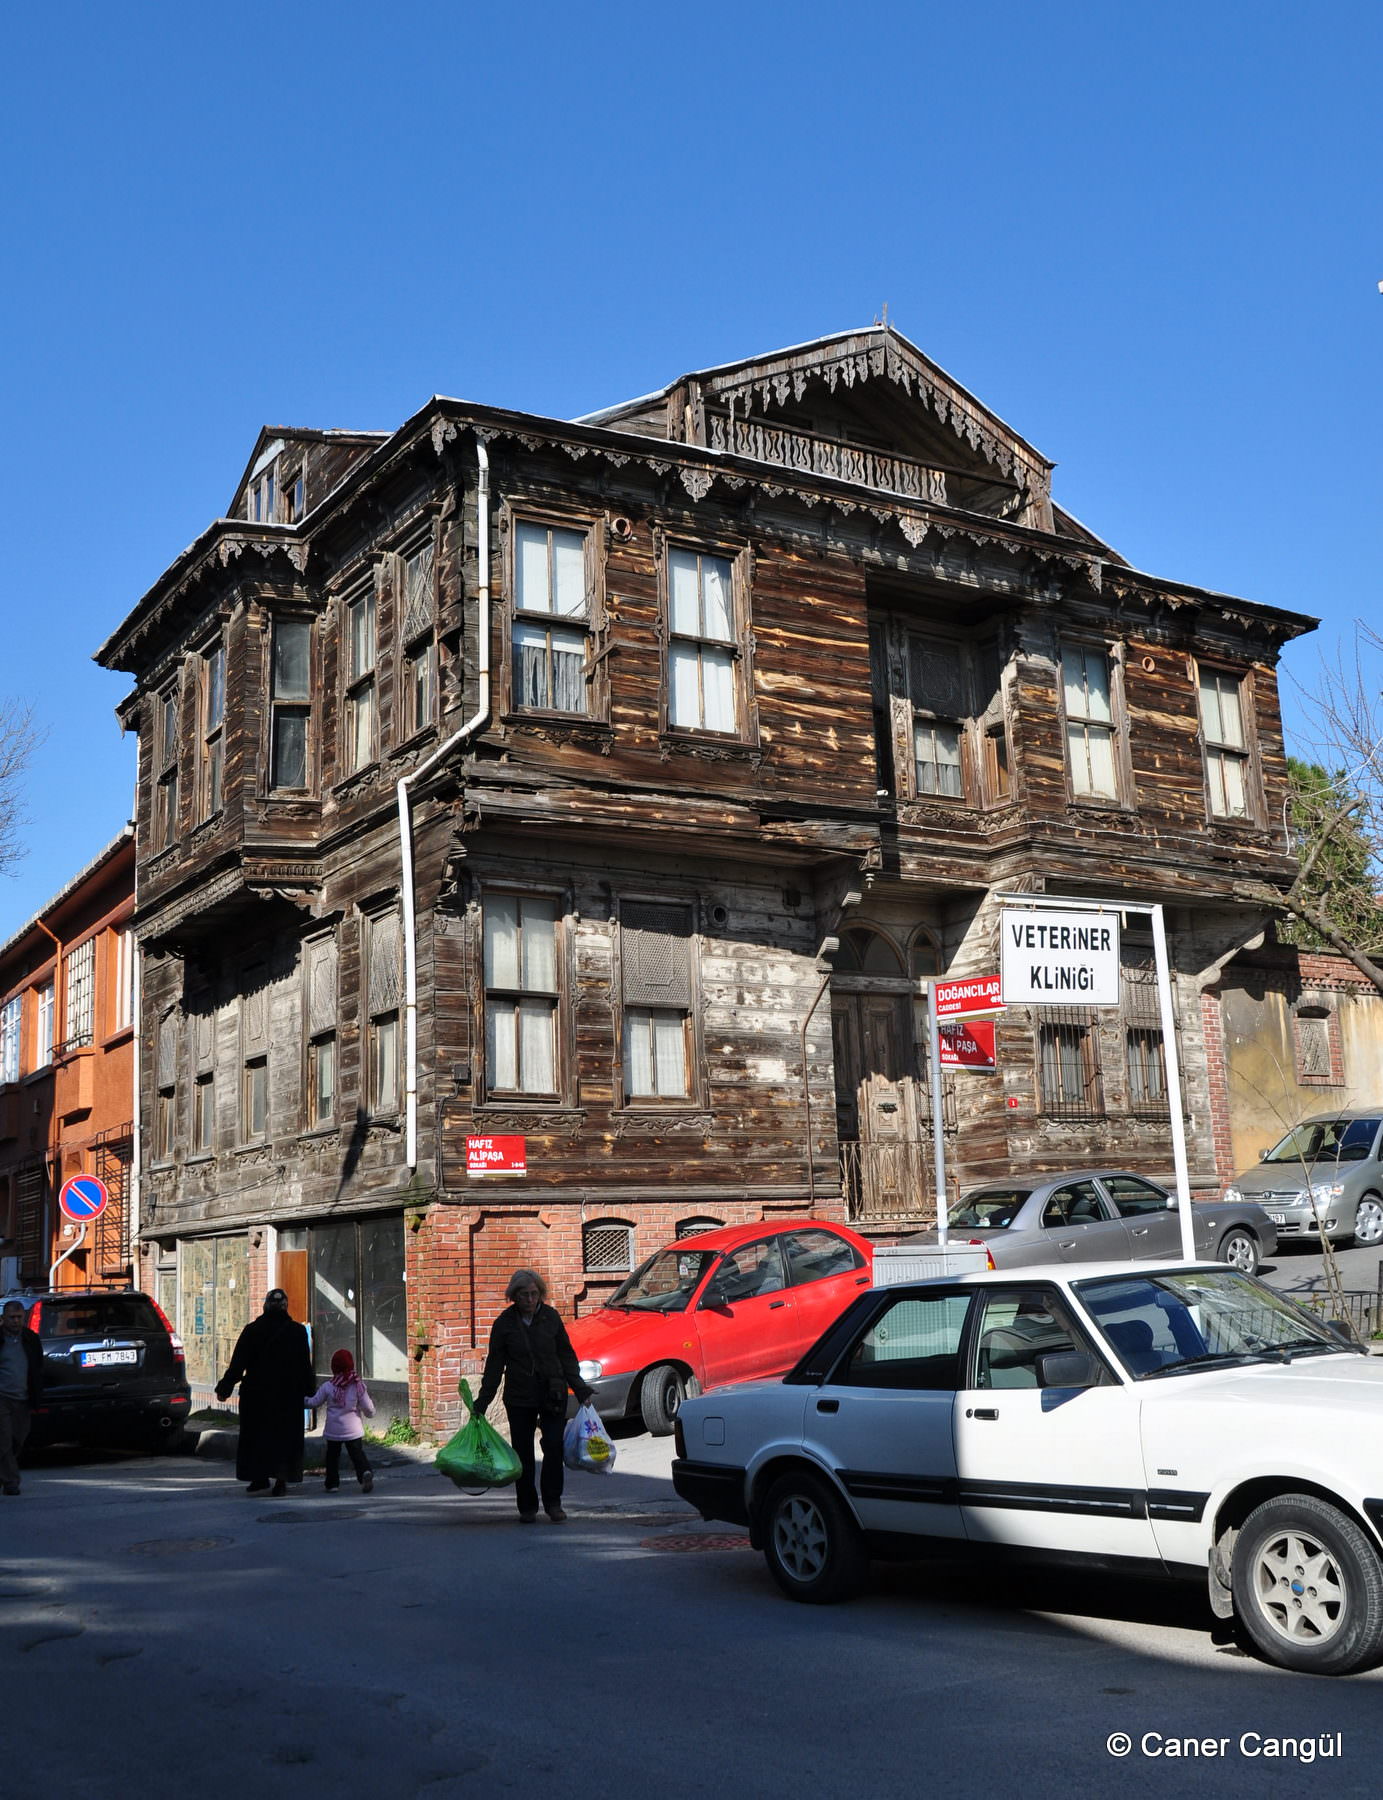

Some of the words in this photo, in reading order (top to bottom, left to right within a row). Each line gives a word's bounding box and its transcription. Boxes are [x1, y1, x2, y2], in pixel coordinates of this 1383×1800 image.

[938, 982, 999, 1001] DOĞANCILAR
[941, 1024, 964, 1036] HAFIZ
[956, 1040, 978, 1054] PAŞA
[468, 1139, 492, 1148] HAFIZ
